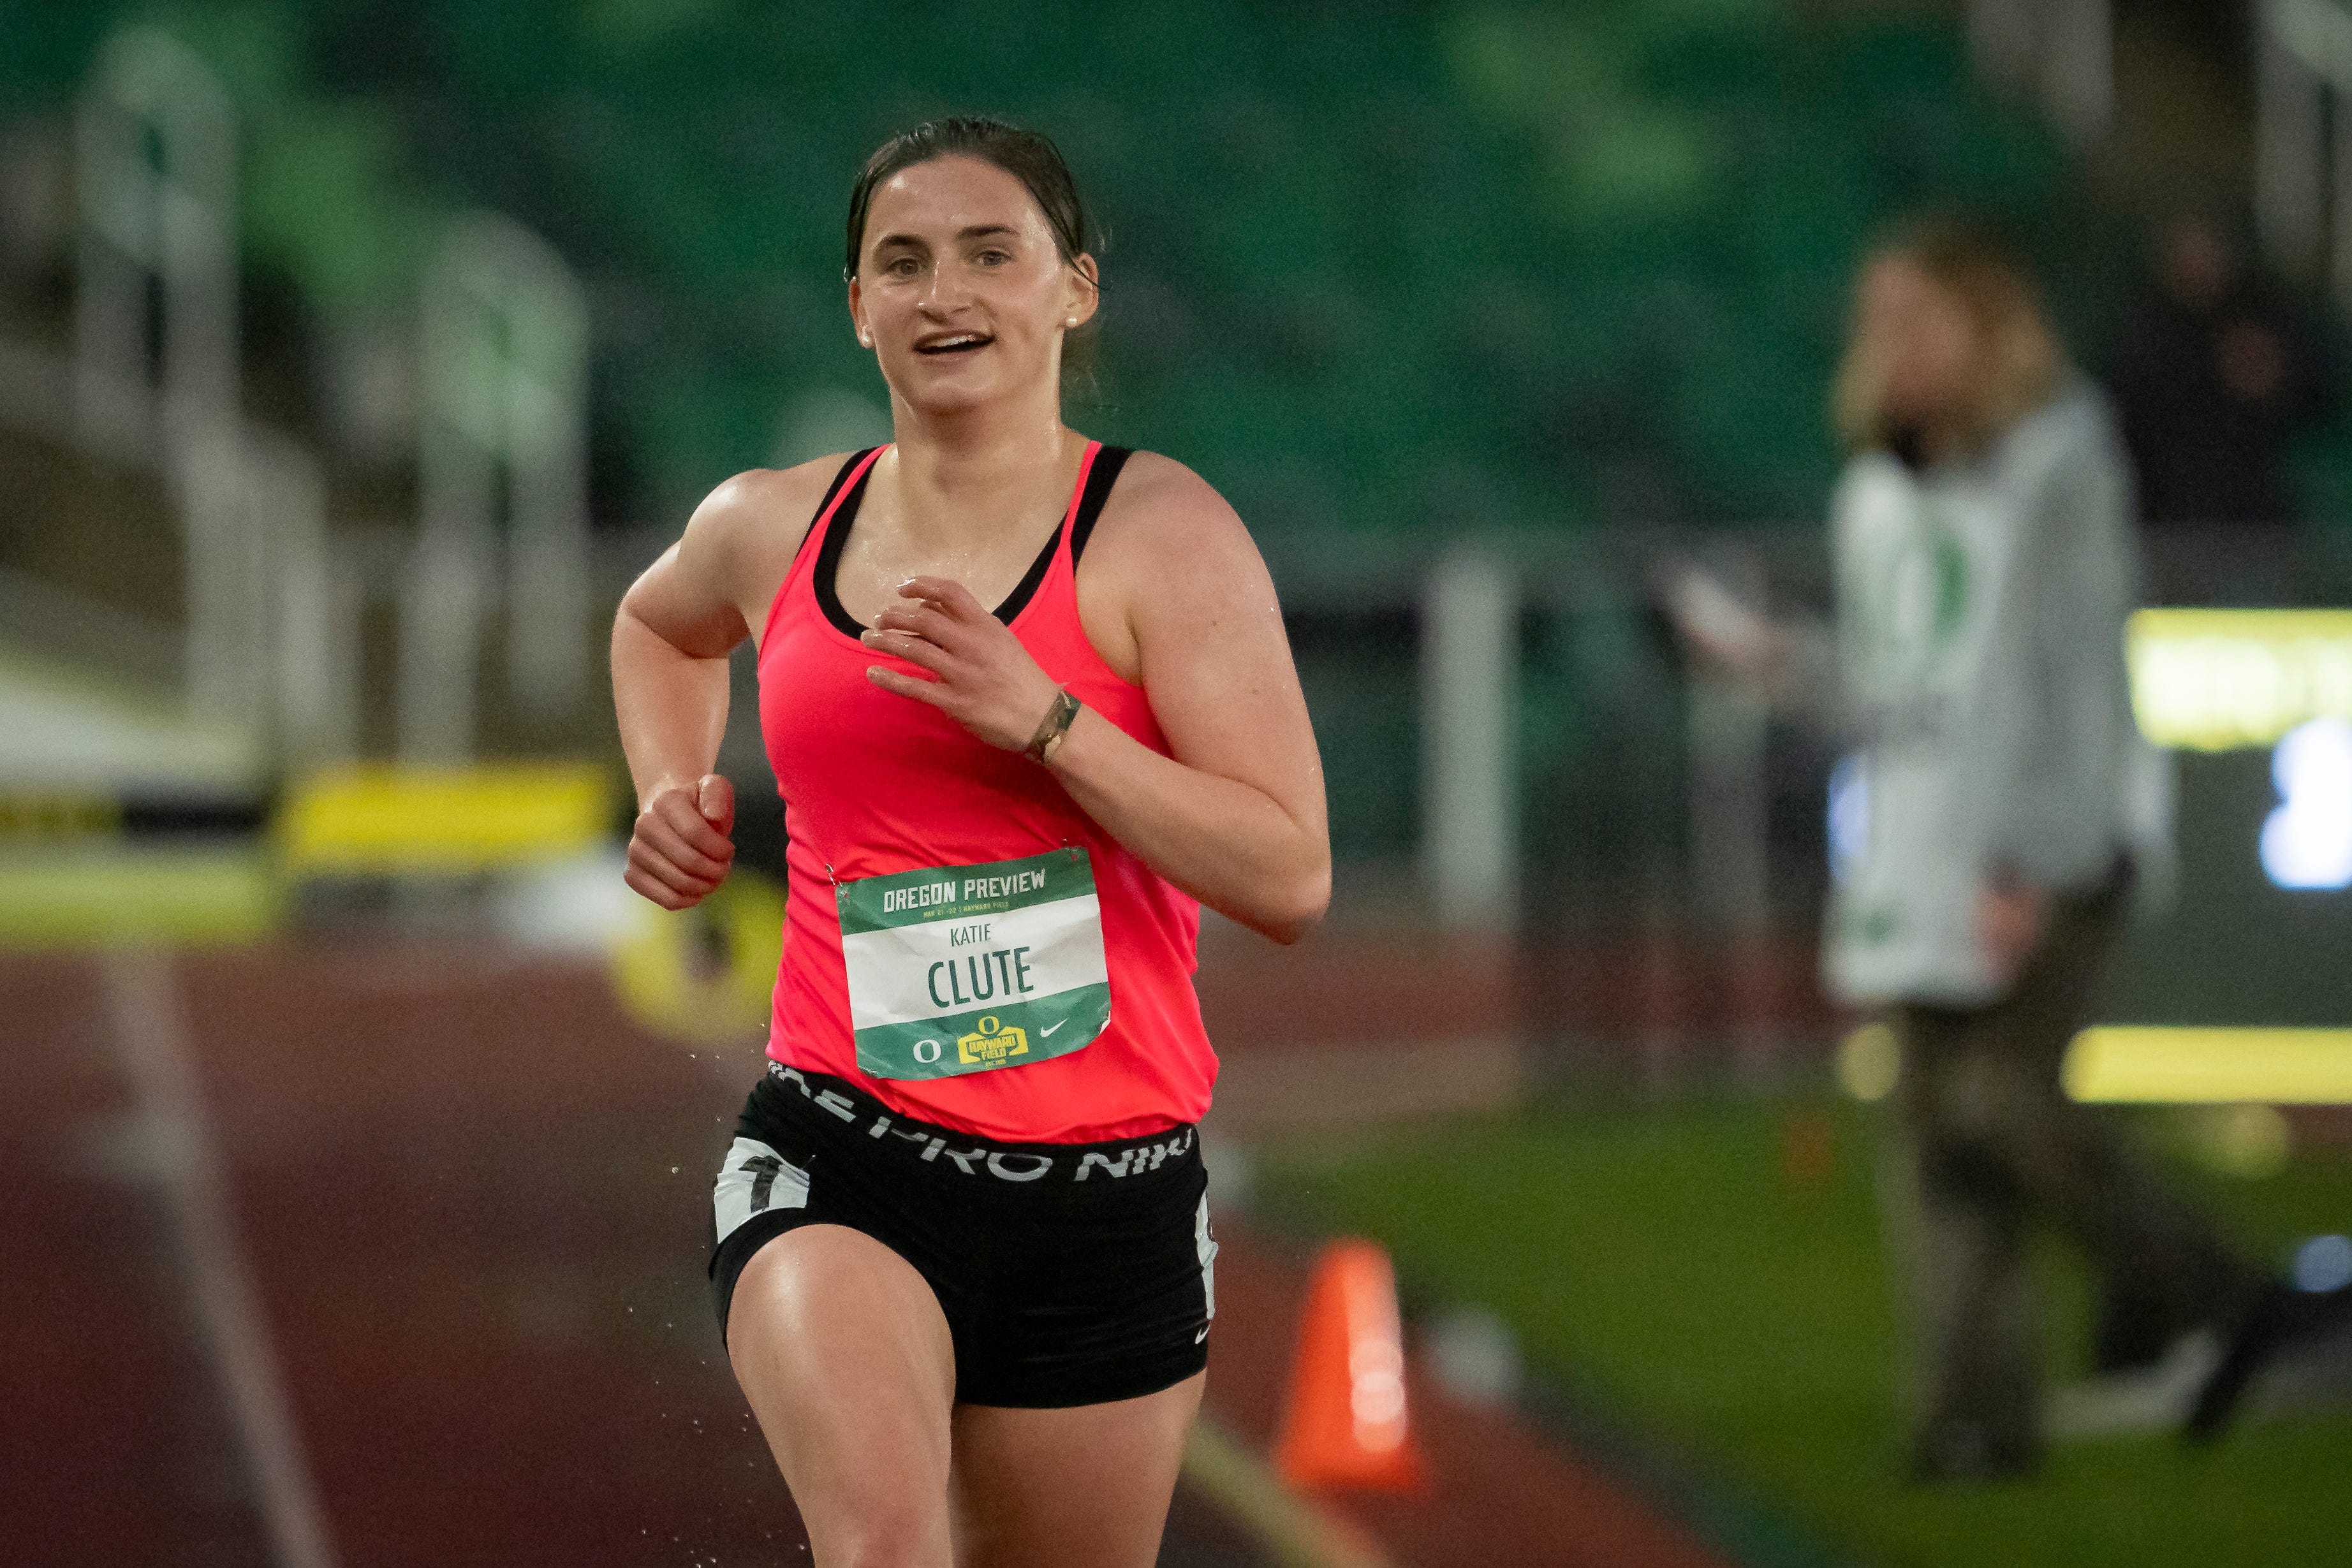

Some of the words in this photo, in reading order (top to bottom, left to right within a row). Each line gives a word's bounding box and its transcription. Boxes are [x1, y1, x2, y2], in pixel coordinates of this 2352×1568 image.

[883, 881, 956, 913] OREGON
[964, 868, 1046, 901] PREVIEW
[950, 923, 992, 947] KATIE
[927, 946, 1034, 1009] CLUTE
[978, 1015, 1000, 1035] O
[913, 1039, 941, 1064] O
[969, 1034, 1017, 1054] HAYWARD
[981, 1048, 1007, 1060] FIELD
[1073, 1128, 1193, 1181] NIK
